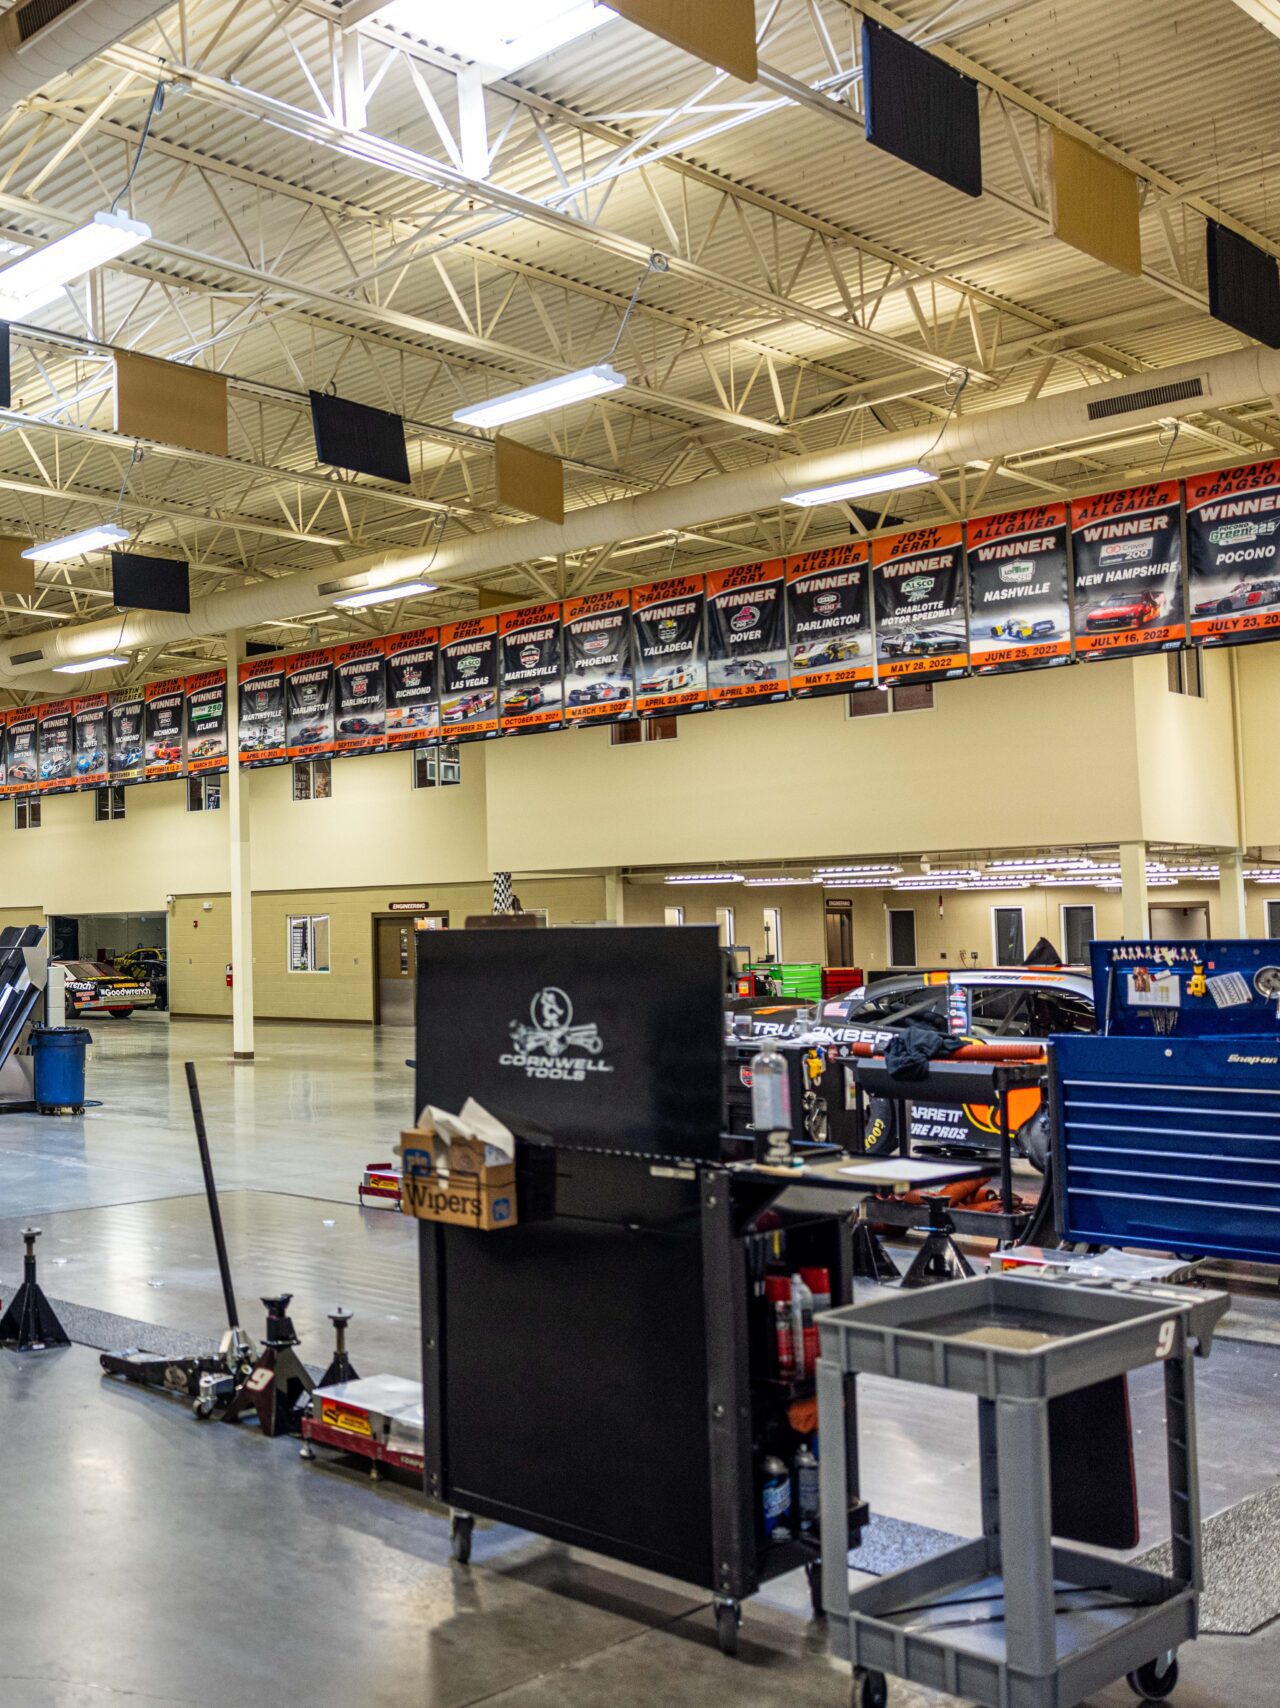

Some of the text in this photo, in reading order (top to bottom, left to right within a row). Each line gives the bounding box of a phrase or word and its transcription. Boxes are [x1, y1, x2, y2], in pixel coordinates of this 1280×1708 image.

[1217, 462, 1273, 482] NOAH
[1195, 475, 1280, 498] GRAGSO
[1092, 484, 1160, 506] JUSTIN
[1078, 493, 1169, 520] ALLGAIER
[1200, 495, 1280, 522] WINNE
[987, 506, 1049, 527] JUSTIN
[973, 515, 1057, 540] ALLGAIER
[1084, 515, 1169, 542] WINNER
[898, 528, 939, 544] JOSH
[802, 544, 855, 563] JUSTIN
[890, 536, 941, 556] BERRY
[978, 536, 1056, 562] WINNER
[792, 552, 861, 574] ALLGAIER
[1216, 546, 1276, 565] POCONO
[728, 563, 763, 578] JOSH
[882, 554, 953, 579] WINNER
[1076, 561, 1178, 587] NEW HAMPSHIRE
[651, 577, 686, 592] NOAH
[722, 572, 766, 588] BERRY
[795, 572, 861, 595] WINNER
[583, 592, 614, 605] NOAH
[638, 585, 697, 604] GRAGSON
[716, 588, 776, 609] WINNER
[984, 582, 1051, 602] NASHVILLE
[516, 605, 546, 618] NOAH
[570, 599, 623, 617] GRAGSON
[640, 602, 696, 622] WINNER
[895, 601, 944, 615] CHARLOTTE
[455, 619, 481, 630] JOSH
[505, 613, 555, 629] GRAGSON
[796, 613, 861, 632] DARLINGTON
[881, 607, 957, 626] MOTOR SPEEDWAY
[453, 626, 485, 639] BERRY
[571, 615, 623, 635] WINNER
[390, 636, 435, 650] GRAGSON
[400, 630, 426, 641] NOAH
[506, 629, 554, 646] WINNER
[730, 630, 762, 643] DOVER
[1091, 629, 1169, 647] JULY 16, 2022
[348, 642, 373, 651] NOAH
[447, 641, 492, 658] WINNER
[643, 641, 693, 657] TALLADEGA
[985, 645, 1058, 663] JUNE 25, 2022
[252, 659, 273, 669] JOSH
[295, 651, 325, 661] JUSTIN
[391, 651, 434, 667] WINNER
[575, 654, 619, 669] PHOENIX
[249, 666, 275, 676] BERRY
[340, 661, 380, 676] WINNER
[504, 665, 557, 681] MARTINSVILLE
[890, 658, 952, 673] MAY 28, 2022
[244, 678, 280, 692] WINNER
[291, 671, 328, 685] WINNER
[450, 677, 489, 690] LAS VEGAS
[805, 671, 856, 684] MAY 7, 2022
[191, 690, 223, 704] WINNER
[395, 686, 431, 699] RICHMOND
[719, 683, 779, 697] APRIL 30, 2022
[150, 697, 181, 711] WINNER
[341, 695, 380, 707] DARLINGTON
[645, 698, 665, 707] APRIL
[680, 693, 699, 702] 2022
[242, 709, 282, 722] MARTINSVILLE
[292, 703, 329, 715] DARLINGTON
[42, 718, 69, 729] WINNER
[77, 712, 103, 723] WINNER
[10, 724, 35, 735] WINNER
[153, 728, 178, 737] RICHMOND
[197, 721, 218, 731] ATLANTA
[64, 982, 91, 990] wrench
[105, 987, 151, 996] Goodwrench
[753, 1021, 795, 1036] TRU
[499, 1054, 610, 1072] CORNWELL
[1227, 1053, 1278, 1065] Snap-on
[526, 1065, 586, 1081] TOOLS
[911, 1106, 963, 1123] ARRETT
[911, 1123, 928, 1135] IRE
[405, 1183, 482, 1216] Wipers
[1155, 1320, 1176, 1357] 9
[246, 1368, 274, 1391] 9
